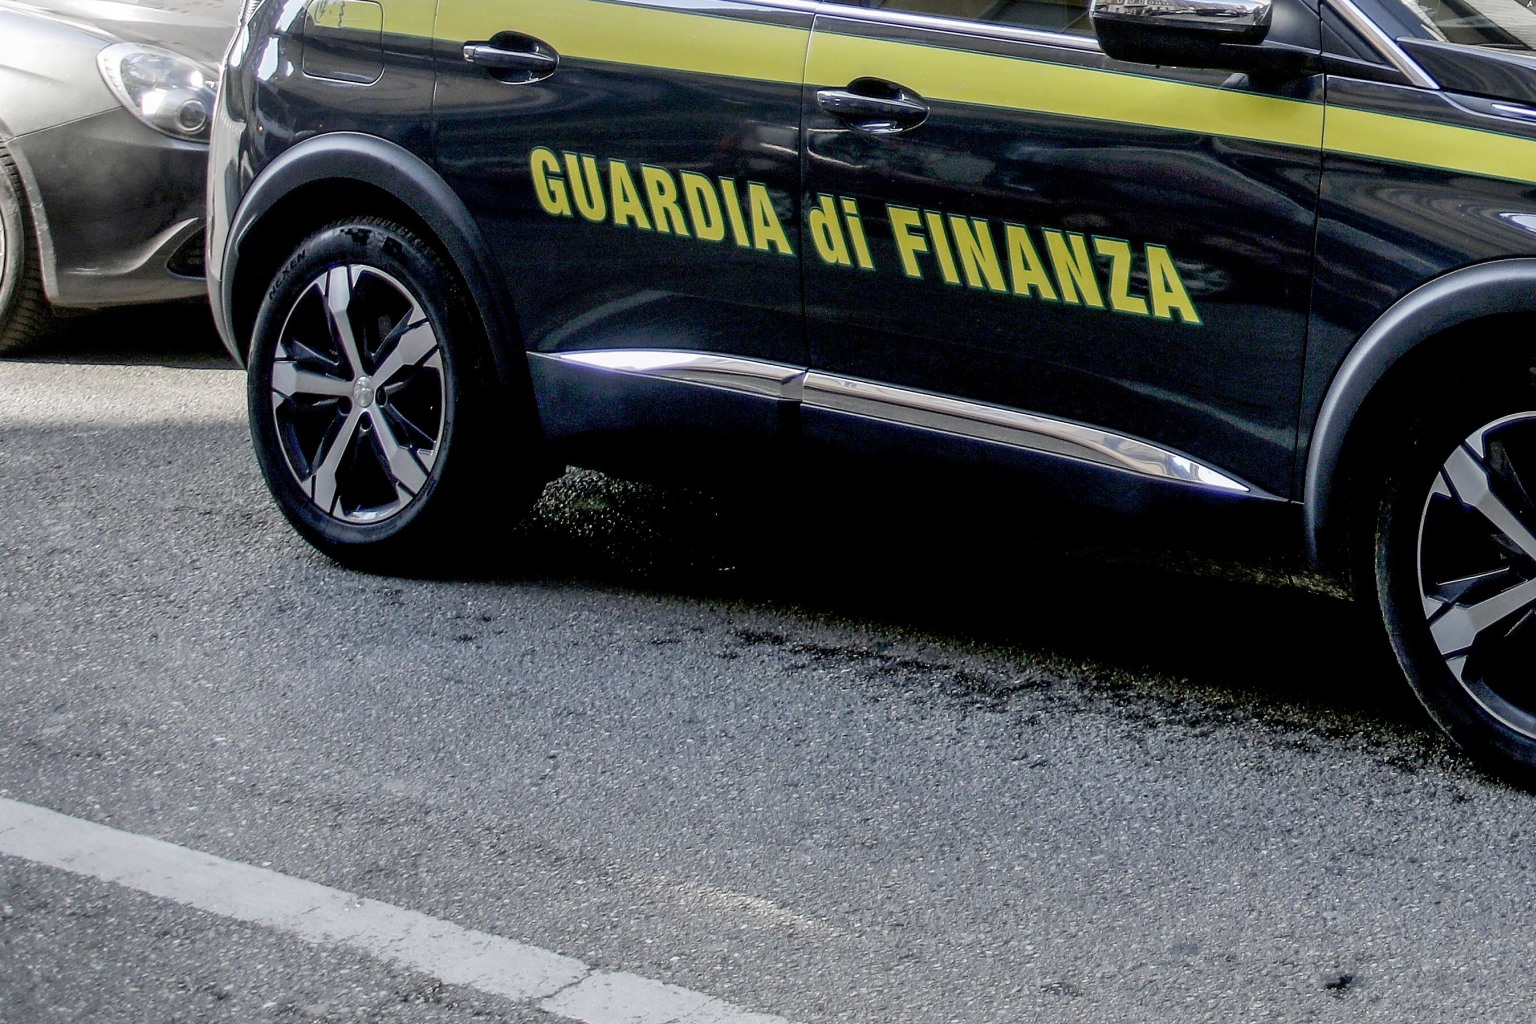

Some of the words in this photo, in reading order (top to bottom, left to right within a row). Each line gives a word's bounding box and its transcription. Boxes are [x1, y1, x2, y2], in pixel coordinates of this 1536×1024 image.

[529, 145, 795, 257] GUARDIA
[807, 193, 876, 270] di
[885, 203, 1203, 326] FINANZA
